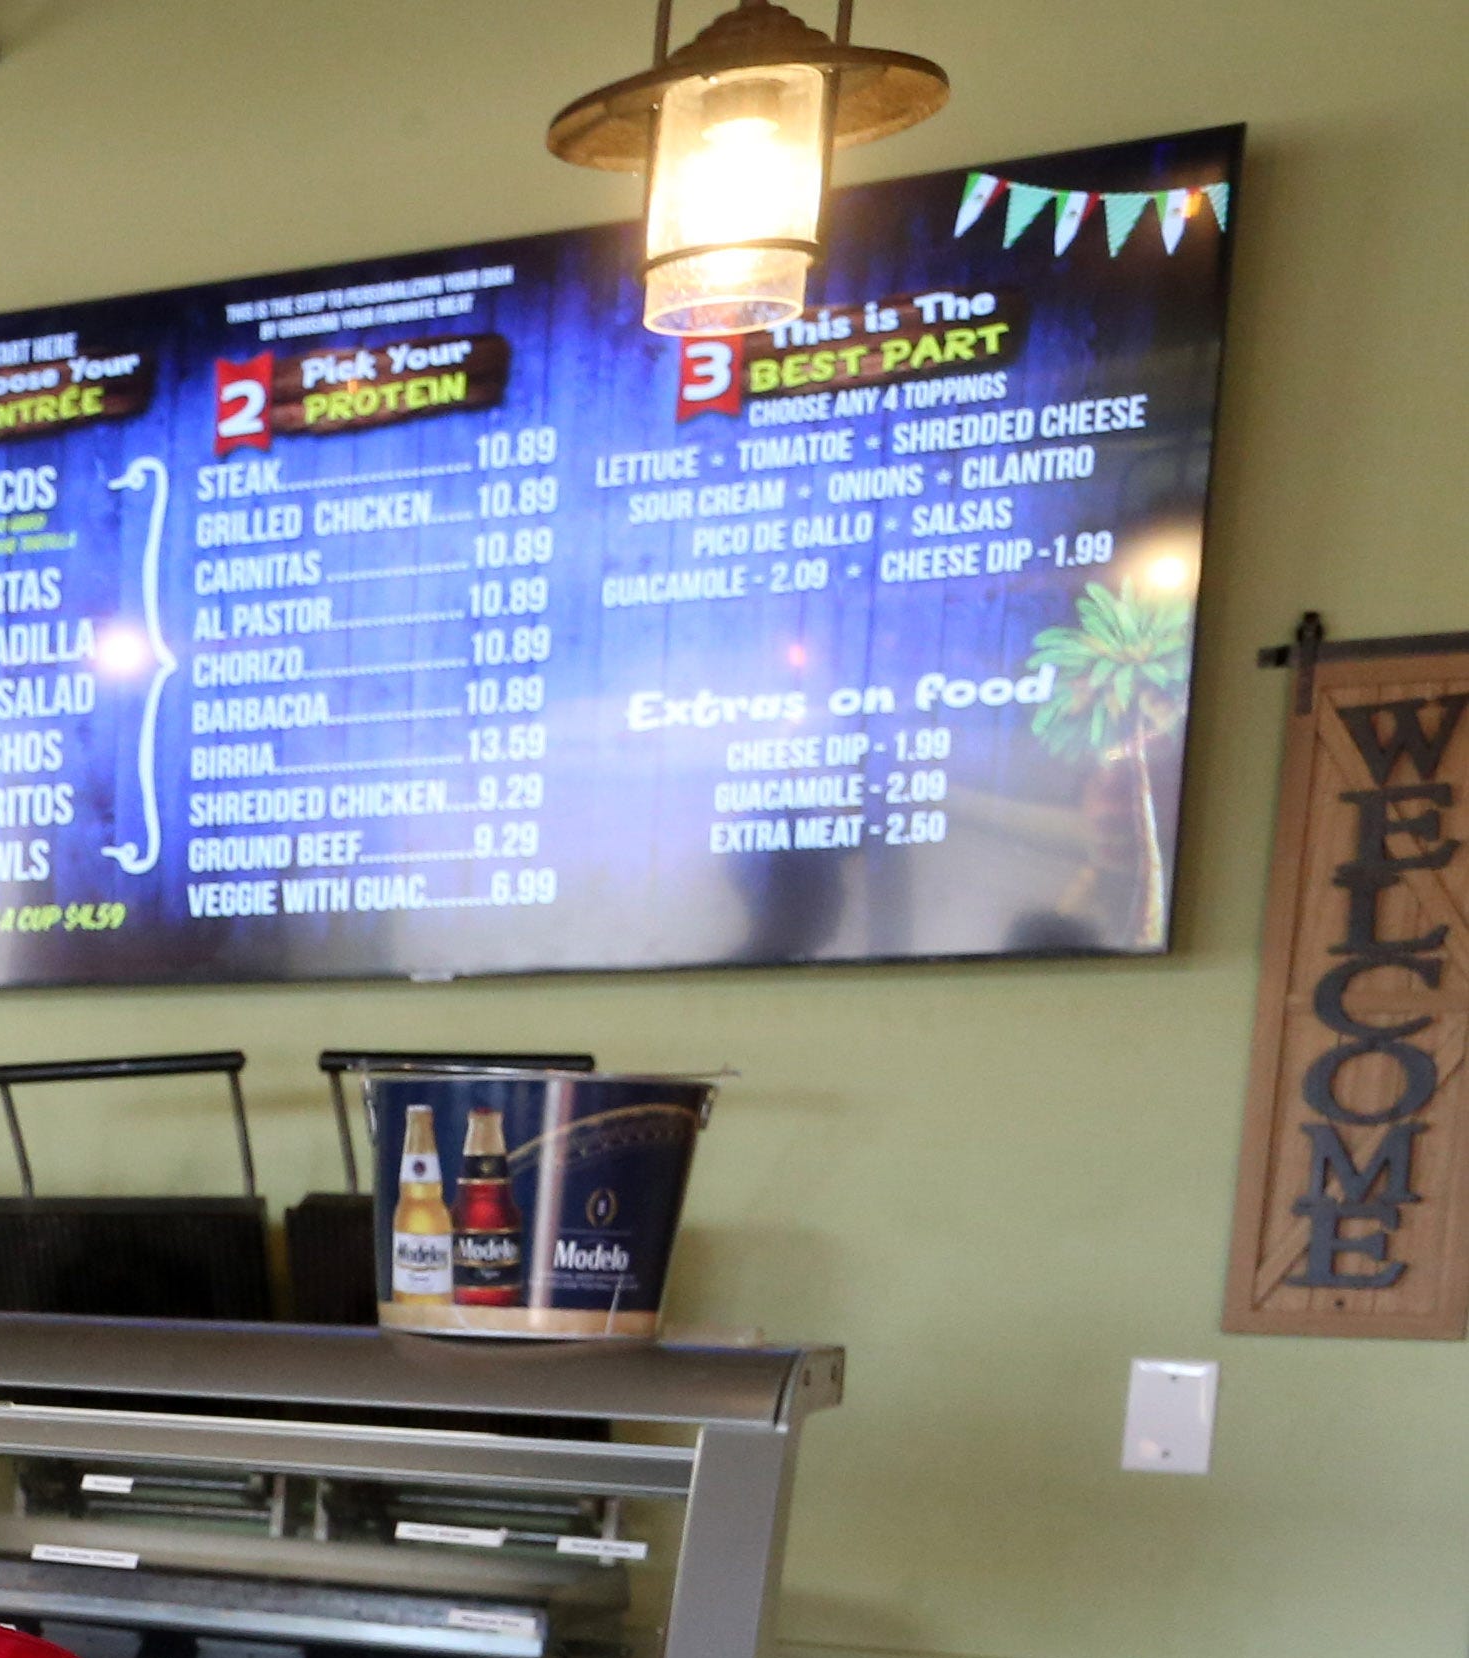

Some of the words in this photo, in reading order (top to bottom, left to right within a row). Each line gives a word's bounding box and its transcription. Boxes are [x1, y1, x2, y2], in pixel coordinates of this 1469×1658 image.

[767, 309, 852, 349] This
[864, 301, 899, 333] is
[913, 291, 997, 325] The
[66, 352, 141, 383] Your
[300, 351, 378, 390] Pick
[387, 340, 472, 374] Your
[682, 341, 733, 401] 3
[749, 345, 868, 394] BEST
[881, 322, 1010, 372] PART
[217, 379, 266, 438] 2
[301, 371, 468, 425] PROTEIN
[749, 392, 832, 428] CHOOSE
[834, 386, 880, 419] ANY
[882, 384, 899, 411] 4
[904, 371, 1008, 410] TOPPINGS
[196, 457, 282, 502] STEAK
[476, 426, 557, 470] 10.89
[595, 445, 701, 488] LETTUCE
[737, 428, 855, 472] TOMATOE
[892, 407, 1035, 455] SHREDDED
[1040, 393, 1148, 439] CHEESE
[195, 503, 303, 549] GRILLED
[313, 489, 433, 537] CHICKEN
[476, 475, 559, 519] 10.89
[628, 488, 694, 525] SOUR
[698, 478, 786, 518] CREAM
[828, 463, 924, 504] ONIONS
[962, 444, 1094, 490] CILANTRO
[693, 523, 749, 558] PICO
[753, 520, 787, 553] DE
[791, 510, 874, 549] GALLO
[912, 496, 1013, 538] SALSAS
[194, 549, 323, 596] CARNITAS
[473, 525, 554, 570] 10.89
[602, 564, 749, 609] GUACAMOLE
[769, 558, 829, 594] 2.09
[880, 542, 981, 583] CHEESE
[986, 537, 1033, 574] DIP
[193, 606, 227, 641] AL
[232, 596, 334, 638] PASTOR
[469, 575, 549, 619] 10.89
[192, 645, 305, 689] CHORIZO
[471, 624, 552, 667] 10.89
[191, 691, 330, 735] BARBACOA
[466, 674, 545, 716] 10.89
[626, 688, 807, 733] Extras
[827, 685, 895, 717] on
[914, 662, 1057, 712] food
[190, 741, 276, 782] BIRRIA
[726, 735, 822, 772] CHEESE
[825, 732, 869, 766] DIP
[895, 727, 952, 762] 1.99
[188, 785, 326, 828] SHREDDED
[330, 779, 447, 820] CHICKEN
[477, 772, 544, 812] 9.29
[714, 774, 863, 813] GUACAMOLE
[885, 769, 947, 803] 2.09
[187, 834, 292, 874] GROUND
[296, 829, 362, 868] BEEF
[473, 821, 539, 859] 9.29
[710, 820, 790, 855] EXTRA
[794, 815, 863, 850] MEAT
[16, 904, 63, 932] CUP
[187, 880, 278, 919] VEGGIE
[281, 876, 350, 914] WITH
[353, 873, 426, 912] GUAC
[490, 867, 557, 906] 6.99
[1284, 692, 1467, 1289] WELCOME
[552, 1239, 630, 1272] Modelo
